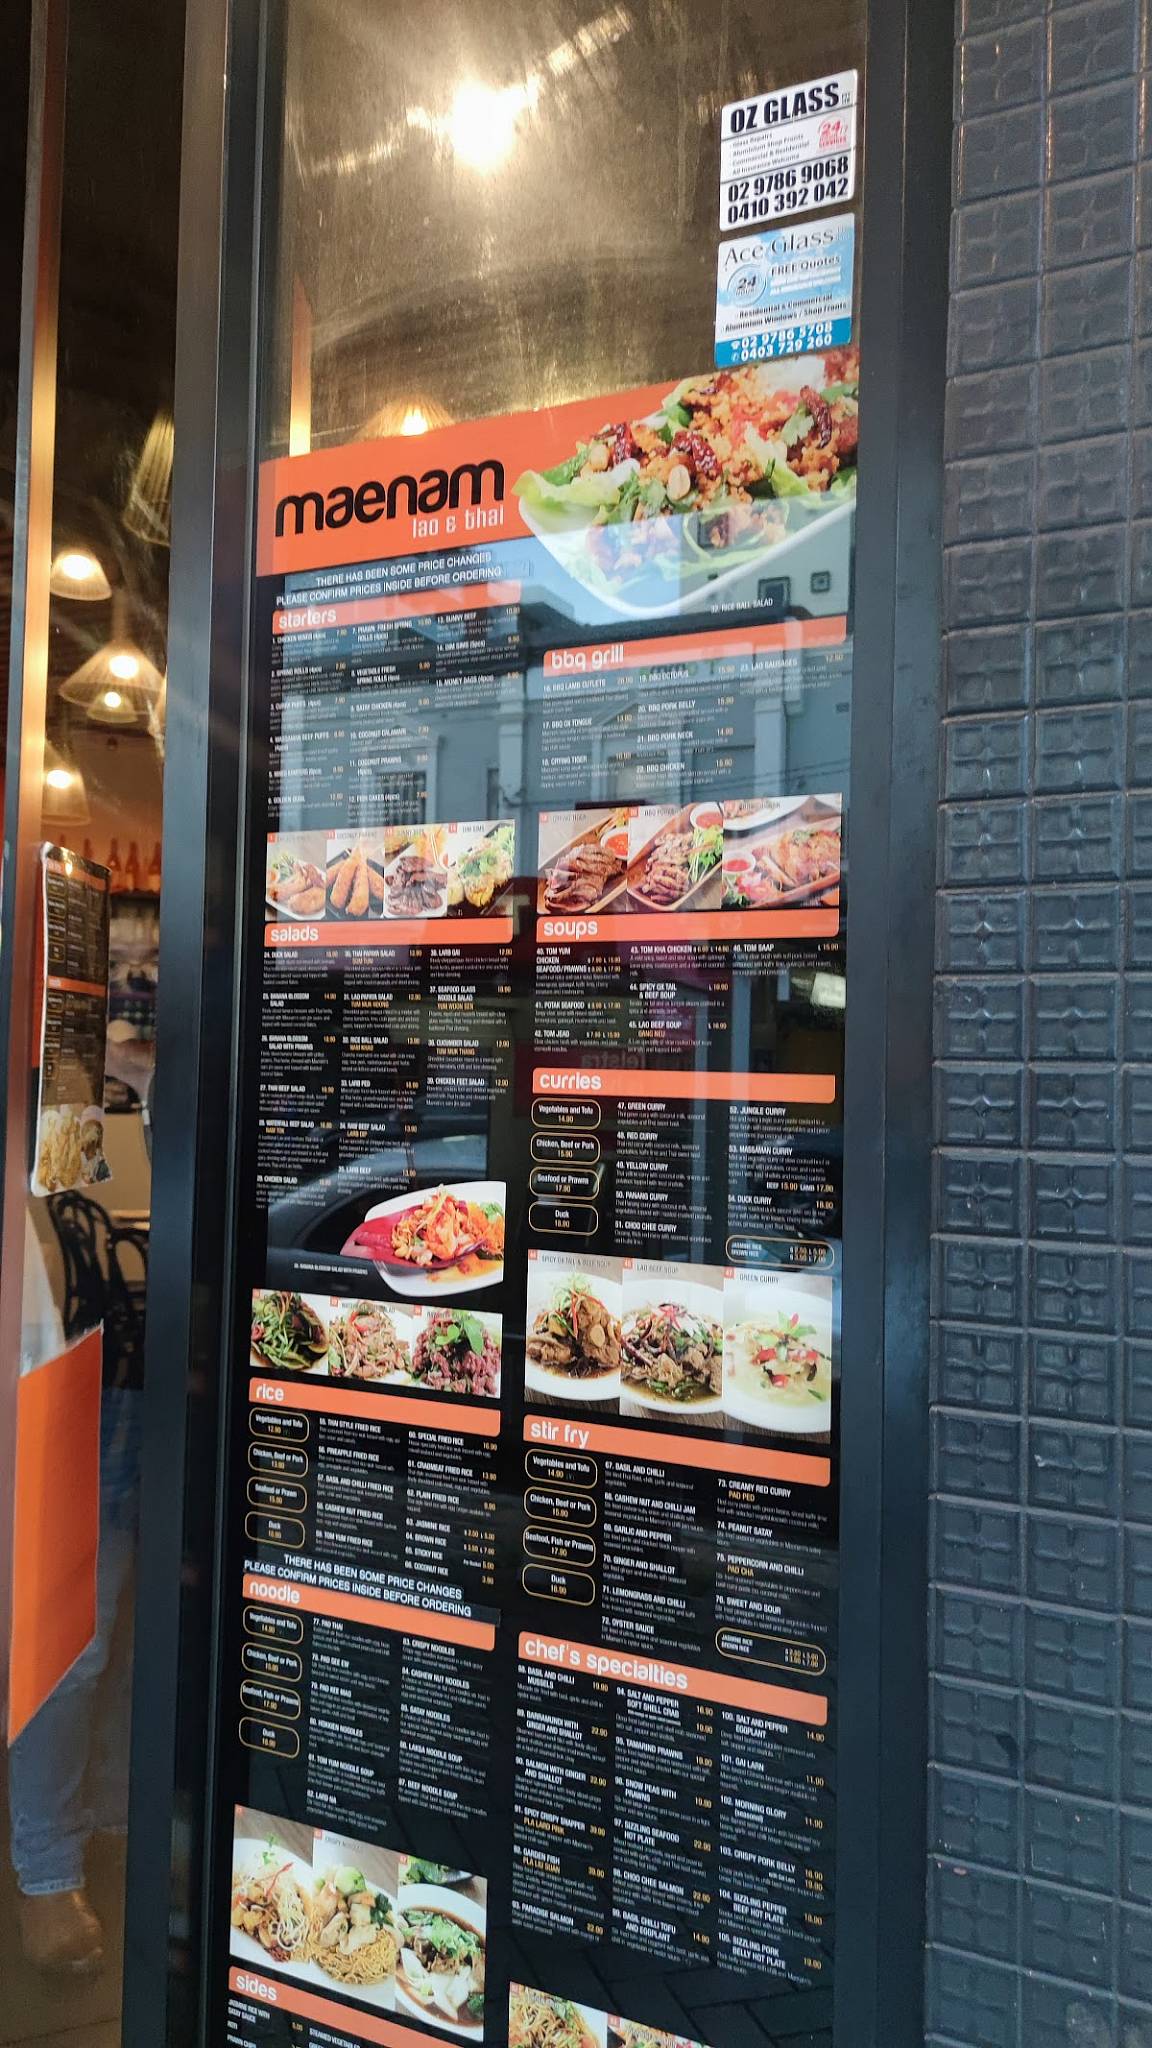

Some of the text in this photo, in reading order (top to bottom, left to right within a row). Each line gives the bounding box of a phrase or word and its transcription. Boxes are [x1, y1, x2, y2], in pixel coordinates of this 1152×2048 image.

[730, 82, 839, 133] OZ GLASS
[728, 156, 849, 202] 02 9786 9068
[728, 178, 849, 223] 0410 392 042
[725, 230, 833, 270] Ace Glass
[741, 336, 757, 348] 02
[275, 459, 505, 537] maenam
[412, 518, 439, 539] lao
[465, 504, 504, 530] thai
[276, 566, 501, 606] PLEASE CONFIRM PRICES INSIDE BEFORE ORDERING
[316, 574, 345, 587] THERE
[346, 570, 363, 582] HAS
[365, 566, 388, 579] BEEN
[390, 562, 416, 577] SOME
[418, 558, 445, 572] PRICE
[279, 609, 337, 629] starters
[551, 644, 624, 671] bbq grill
[271, 925, 319, 942] salads
[544, 920, 598, 940] soups
[539, 1072, 602, 1090] curries
[255, 1384, 284, 1401] rice
[530, 1420, 590, 1450] stir fry
[244, 1560, 472, 1617] PLEASE CONFIRM PRICES INSIDE BEFORE ORDERING
[284, 1554, 462, 1600] THERE HAS BEEN SOME PRICE CHANGES
[249, 1581, 300, 1604] noodle
[525, 1639, 689, 1688] chef's specialties
[235, 1973, 278, 2001] sides
